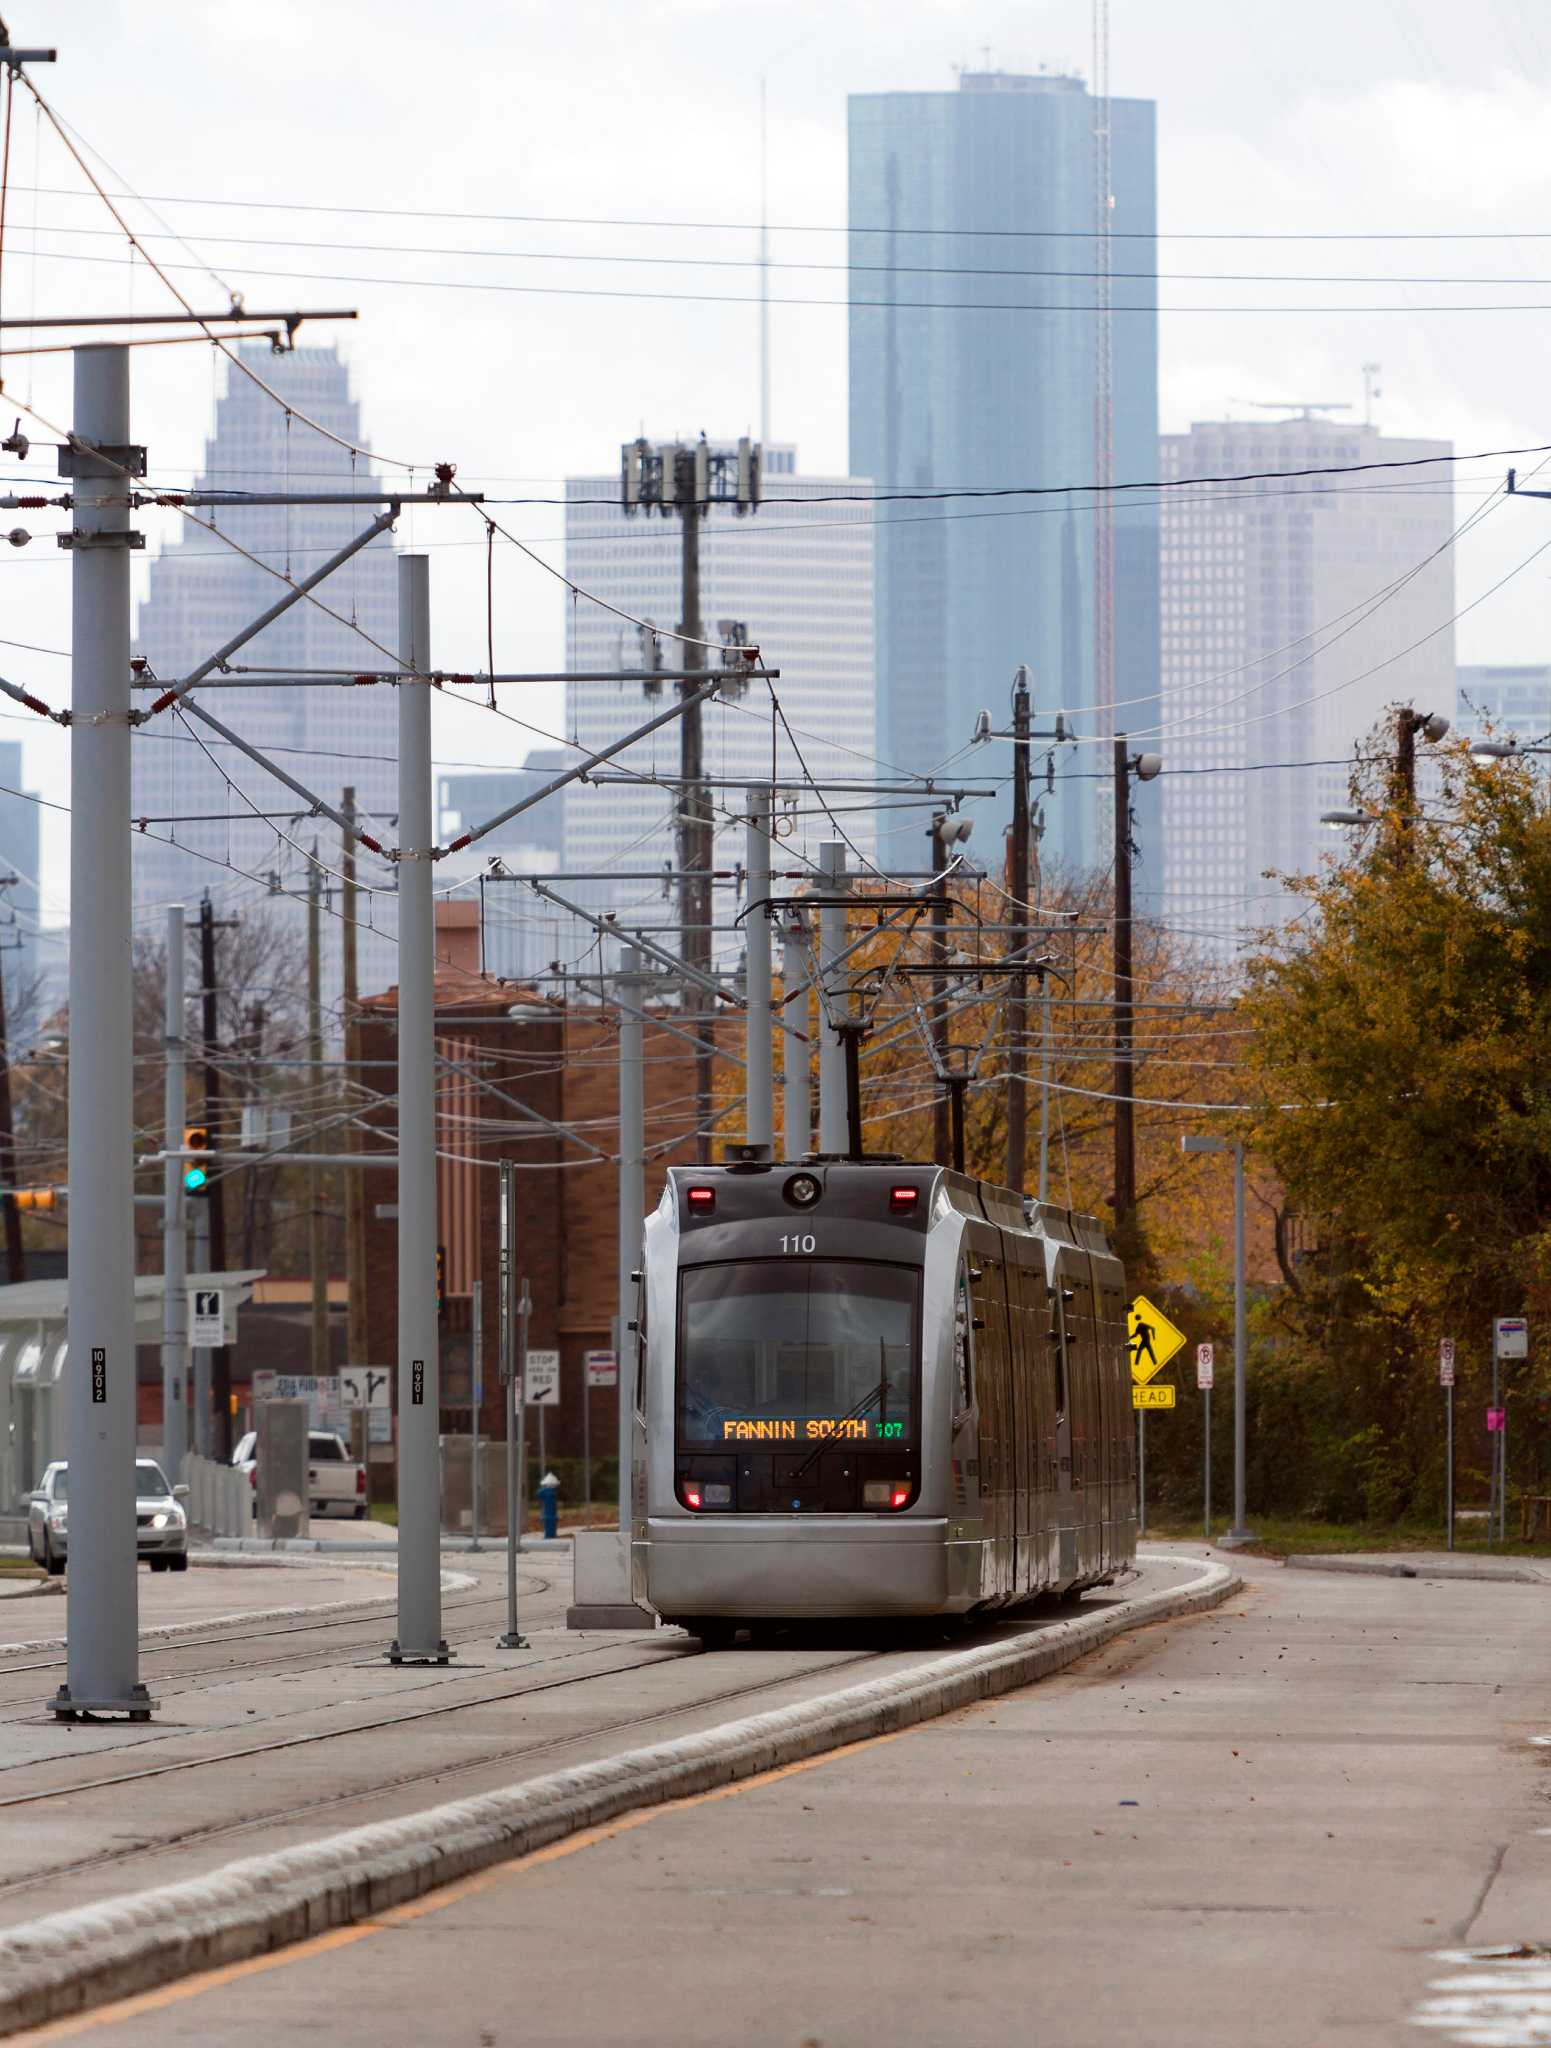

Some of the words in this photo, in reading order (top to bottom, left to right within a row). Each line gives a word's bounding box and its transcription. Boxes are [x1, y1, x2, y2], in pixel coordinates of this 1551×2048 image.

[779, 1234, 816, 1253] 110
[1133, 1391, 1167, 1402] HEAD
[724, 1420, 796, 1439] FANNIN
[806, 1420, 866, 1439] SOUTH
[875, 1423, 902, 1438] 107
